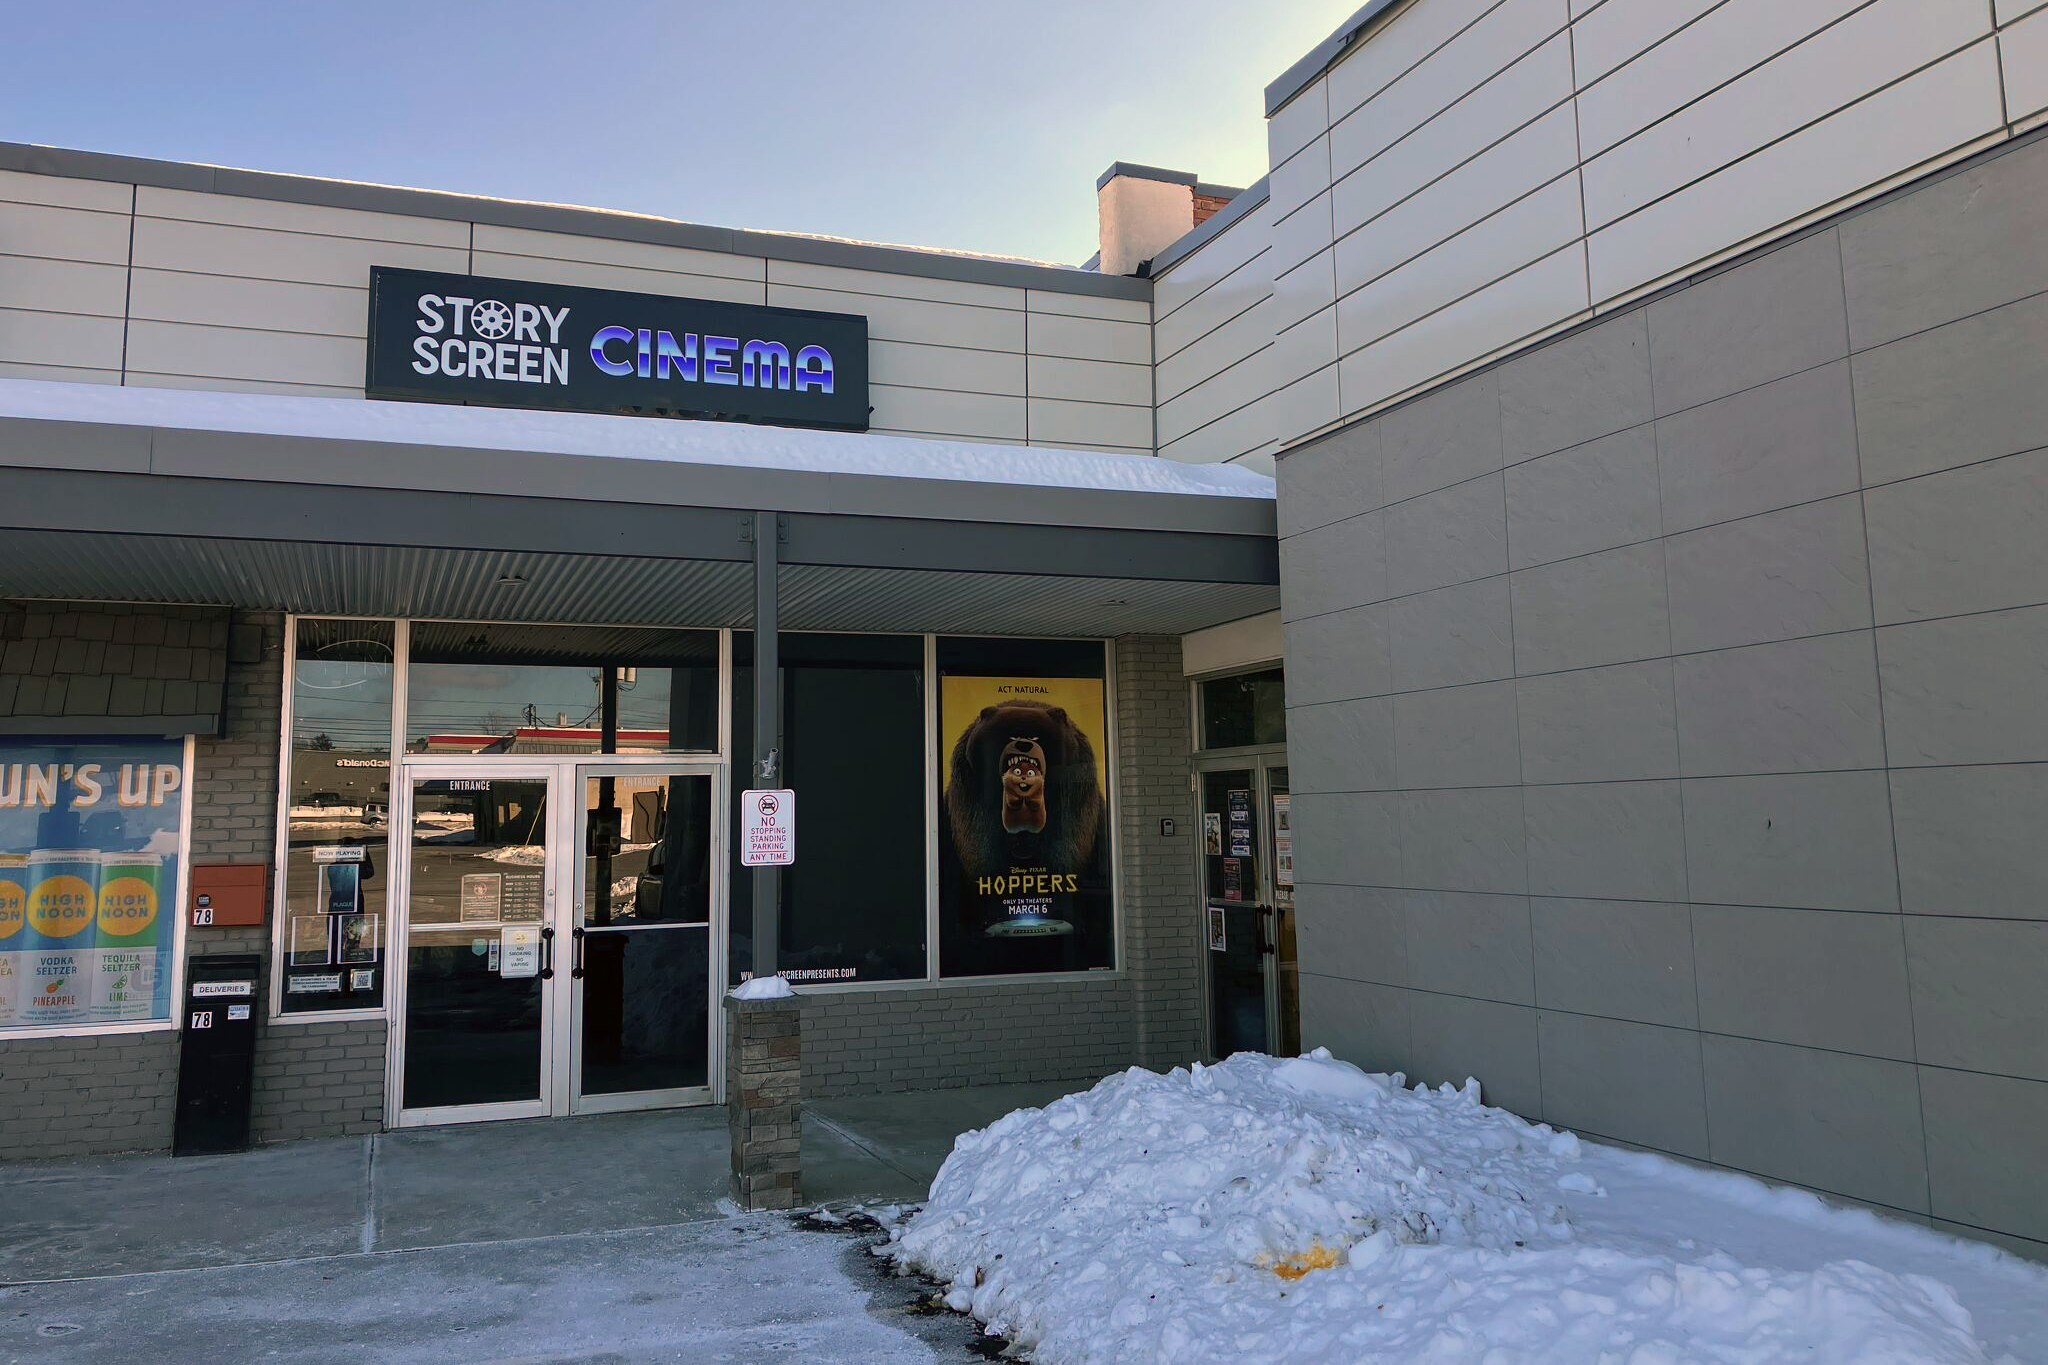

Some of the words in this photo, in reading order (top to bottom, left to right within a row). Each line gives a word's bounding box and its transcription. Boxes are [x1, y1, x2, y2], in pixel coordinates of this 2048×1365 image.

[416, 294, 570, 344] STORY
[412, 335, 568, 385] SCREEN
[590, 325, 835, 394] CINEMA
[998, 685, 1012, 693] ACT
[1014, 685, 1049, 694] NATURAL
[118, 764, 181, 806] UP
[450, 780, 490, 790] ENTRANCE
[624, 777, 660, 787] ENTRANCE
[761, 816, 775, 827] NO
[979, 874, 1078, 895] HOPPERS
[40, 894, 85, 906] HIGH
[104, 894, 147, 906] HIGH
[37, 907, 86, 918] NOON
[102, 907, 148, 918] NOON
[1008, 905, 1039, 915] MARCH
[1041, 904, 1048, 914] 6
[195, 909, 211, 924] 78
[40, 956, 74, 966] VODKA
[102, 954, 141, 964] TEQUILA
[36, 966, 77, 976] SELTZER
[102, 963, 141, 972] SELTZER
[199, 985, 245, 993] DELIVERIES
[32, 995, 76, 1006] PINEAPPLE
[109, 992, 128, 1002] LIME
[194, 1012, 210, 1028] 78
